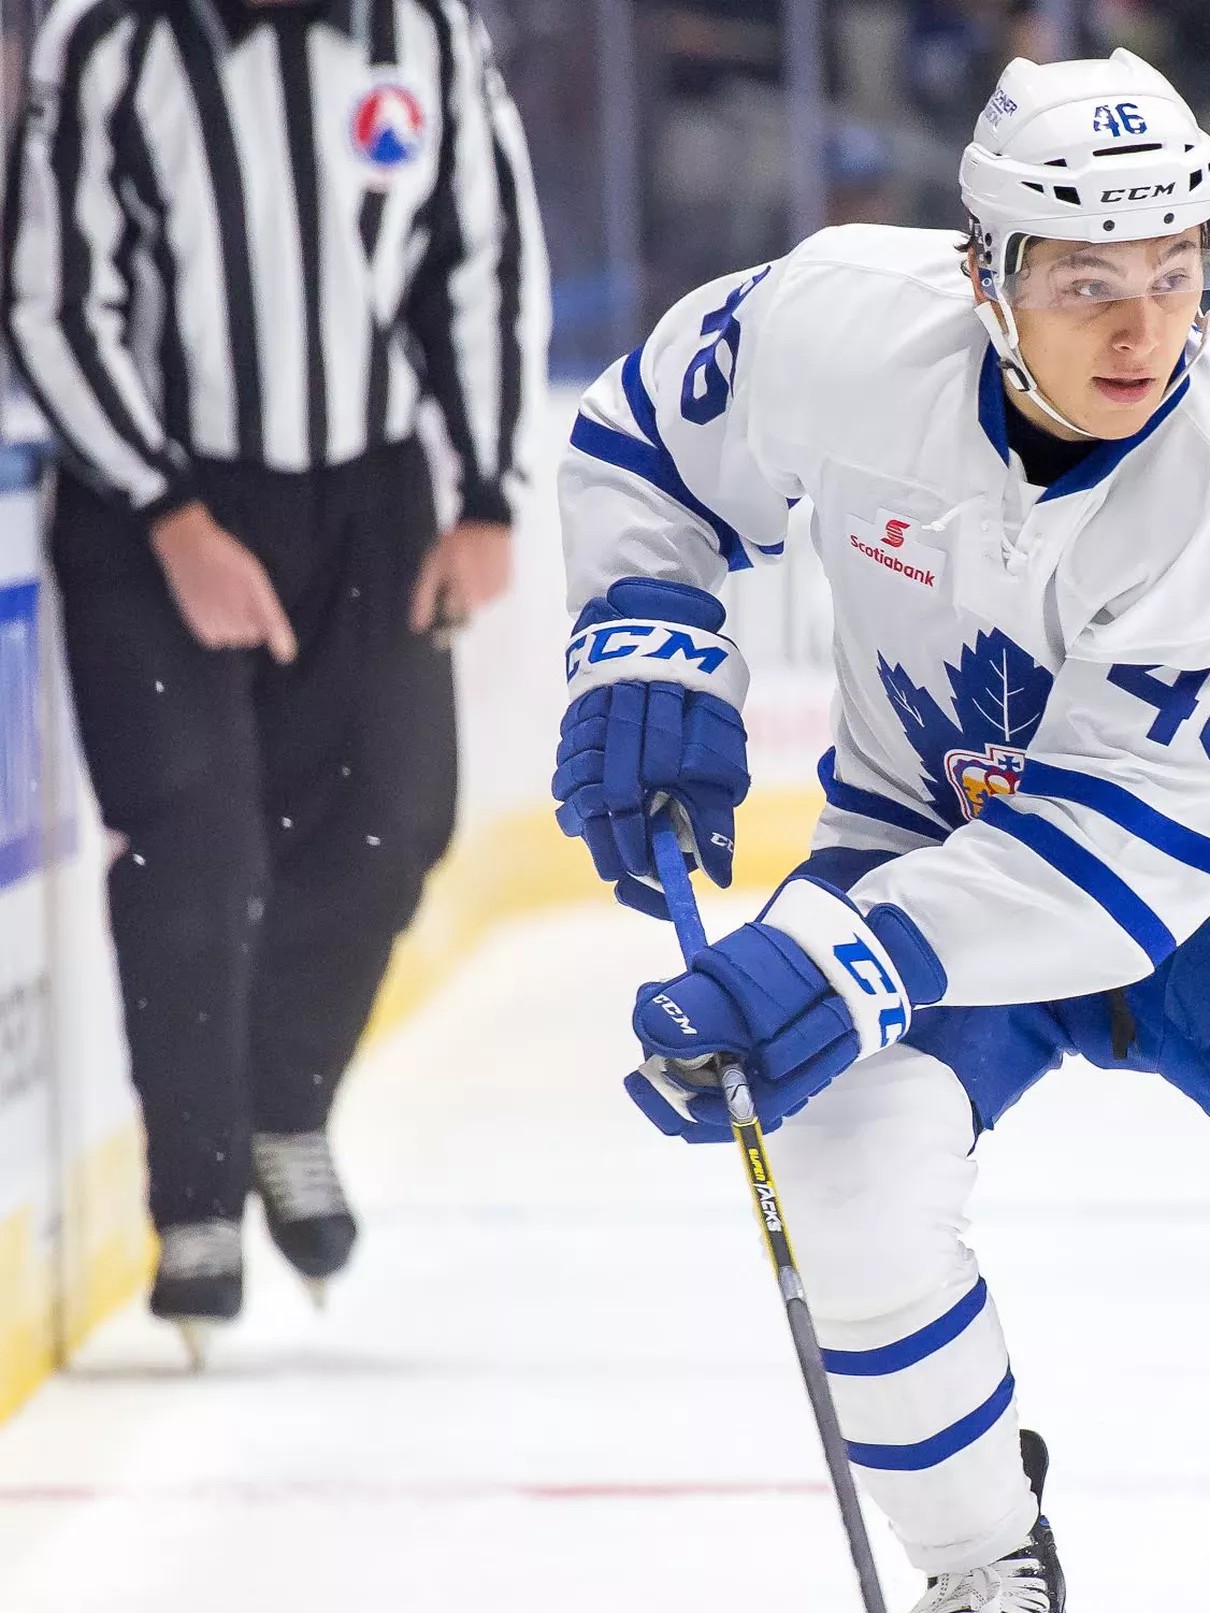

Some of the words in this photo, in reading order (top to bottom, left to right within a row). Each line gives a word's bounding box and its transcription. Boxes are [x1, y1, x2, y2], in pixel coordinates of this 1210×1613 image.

[1092, 102, 1148, 137] 46
[1099, 181, 1177, 203] CCM
[850, 534, 935, 588] Scotiabank
[565, 625, 730, 684] CCM
[652, 993, 698, 1035] CCM
[752, 1180, 783, 1233] TACKS
